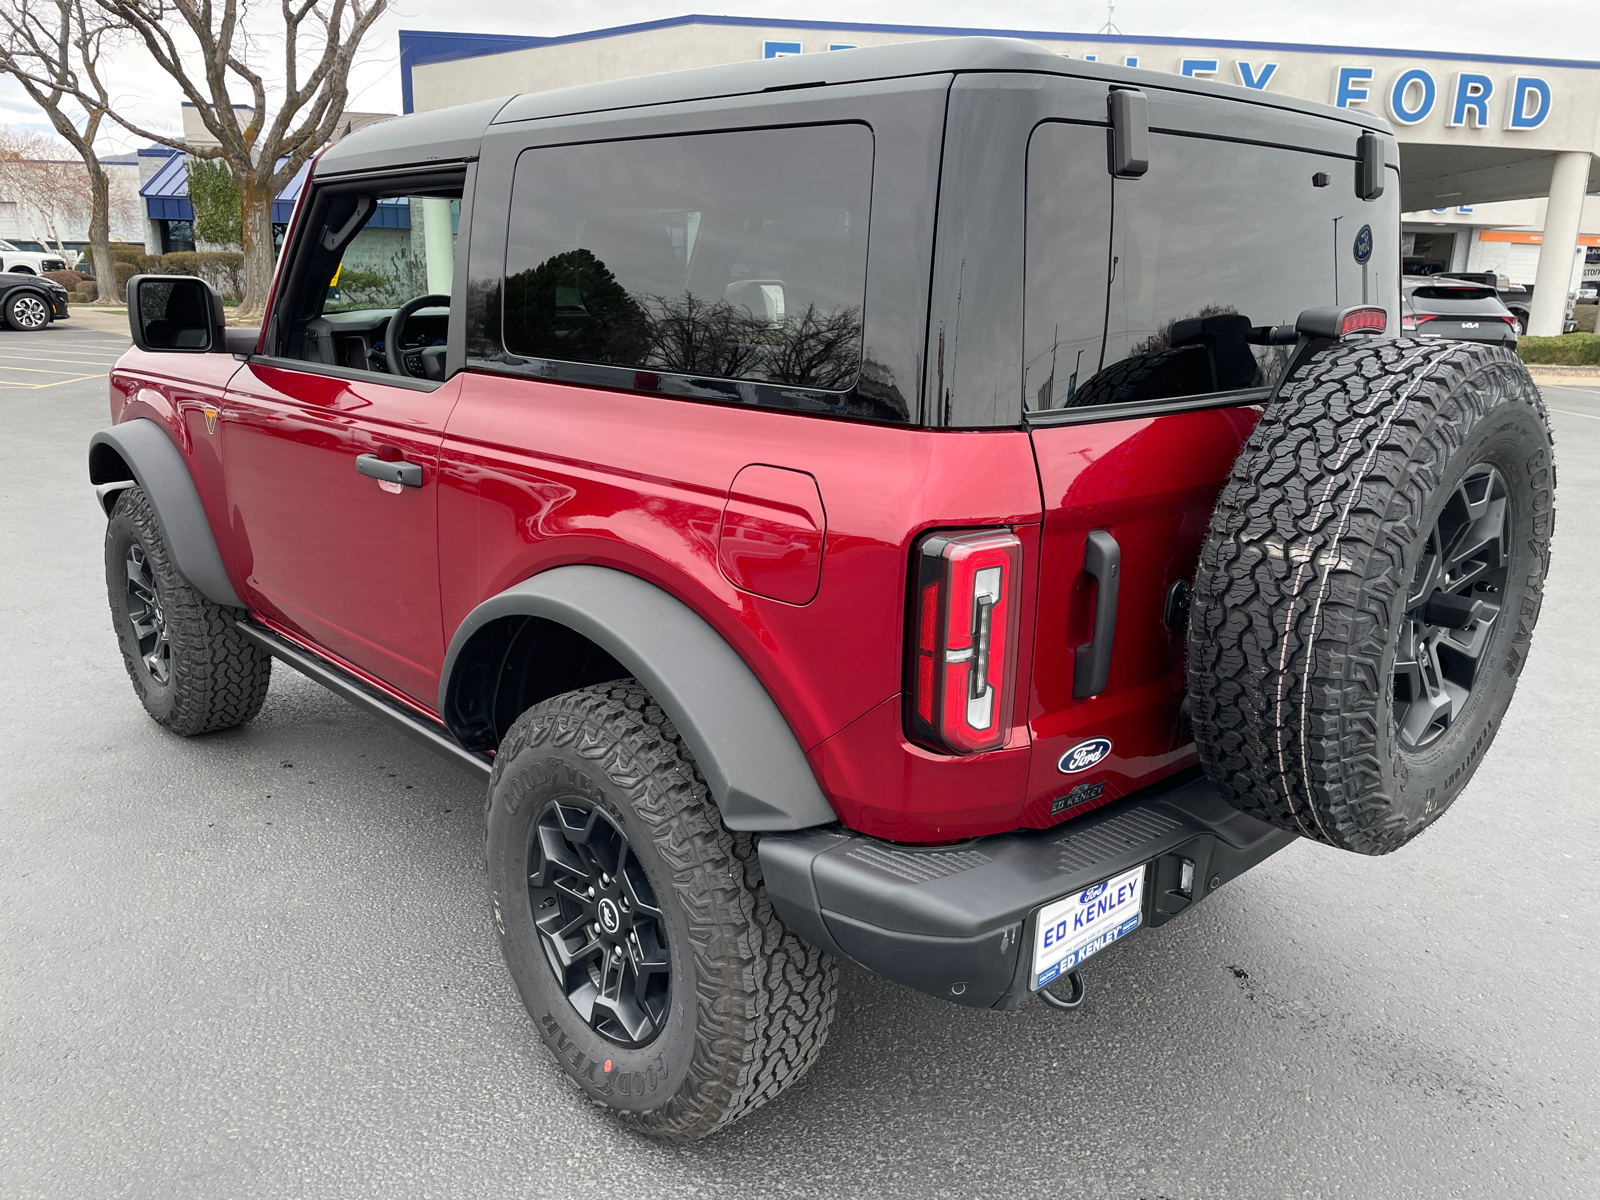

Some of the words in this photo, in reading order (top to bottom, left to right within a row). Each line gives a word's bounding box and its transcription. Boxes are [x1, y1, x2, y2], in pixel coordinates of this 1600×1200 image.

[1333, 65, 1553, 131] FORD
[1502, 448, 1550, 679] GOODYEAR
[1069, 744, 1103, 769] Ford
[1444, 719, 1493, 790] TERRITORY
[503, 756, 627, 826] GOODYEAR
[1051, 801, 1065, 812] ED
[1066, 784, 1104, 807] KENLEY
[1044, 919, 1067, 949] ED
[1073, 878, 1138, 931] KENLEY
[1084, 883, 1105, 903] Ford
[1060, 954, 1076, 972] ED
[1078, 927, 1121, 962] KENLEY
[541, 1010, 669, 1097] GOODYEAR
